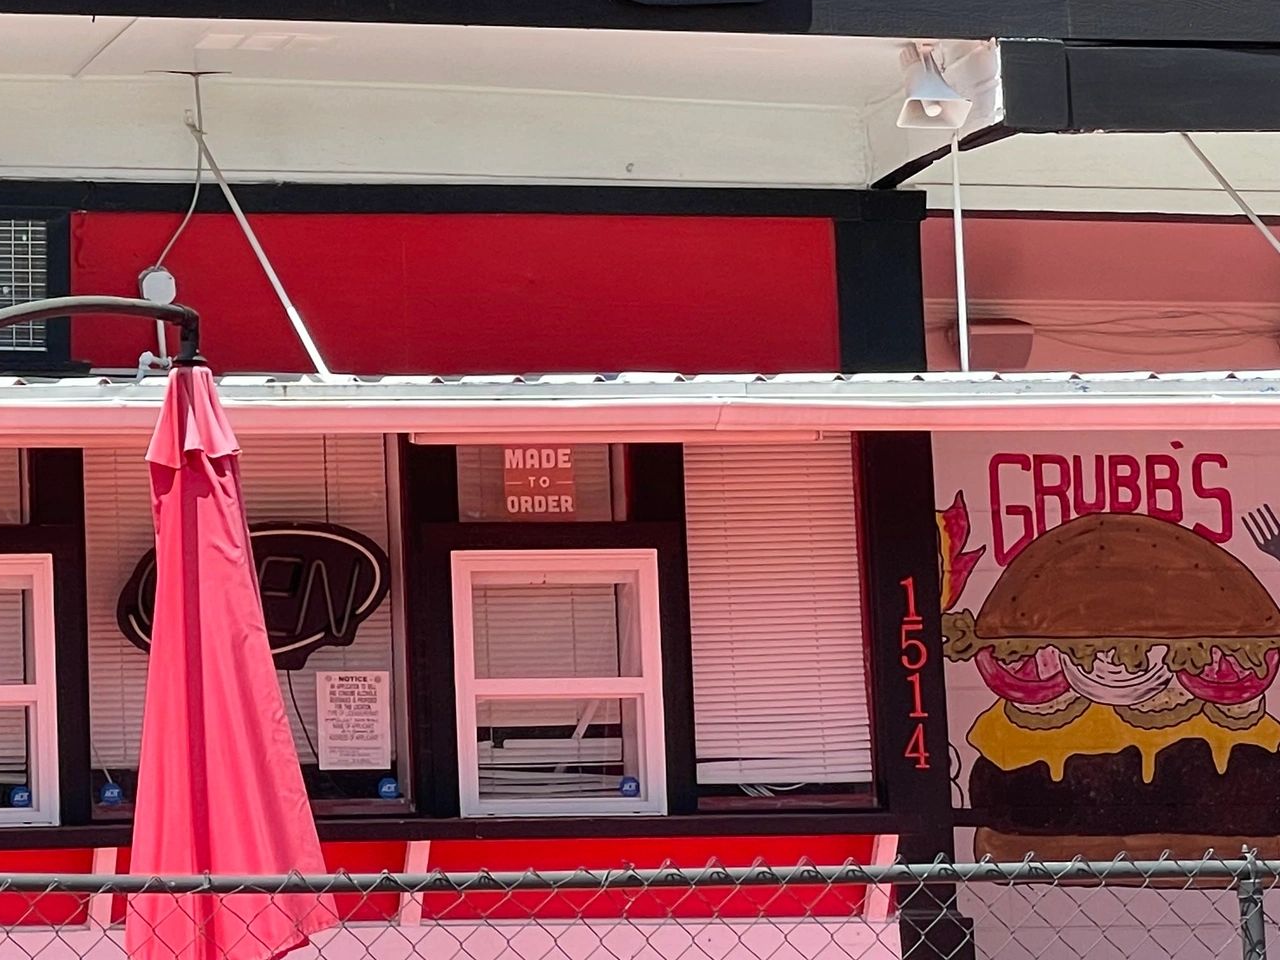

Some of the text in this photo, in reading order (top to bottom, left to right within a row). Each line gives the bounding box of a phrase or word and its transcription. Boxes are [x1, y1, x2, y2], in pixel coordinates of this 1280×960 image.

[504, 448, 572, 469] MADE
[528, 476, 550, 488] TO
[507, 495, 574, 513] ORDER
[989, 441, 1233, 566] GRUBB'S
[338, 675, 368, 683] NOTICE
[899, 576, 931, 769] 1514
